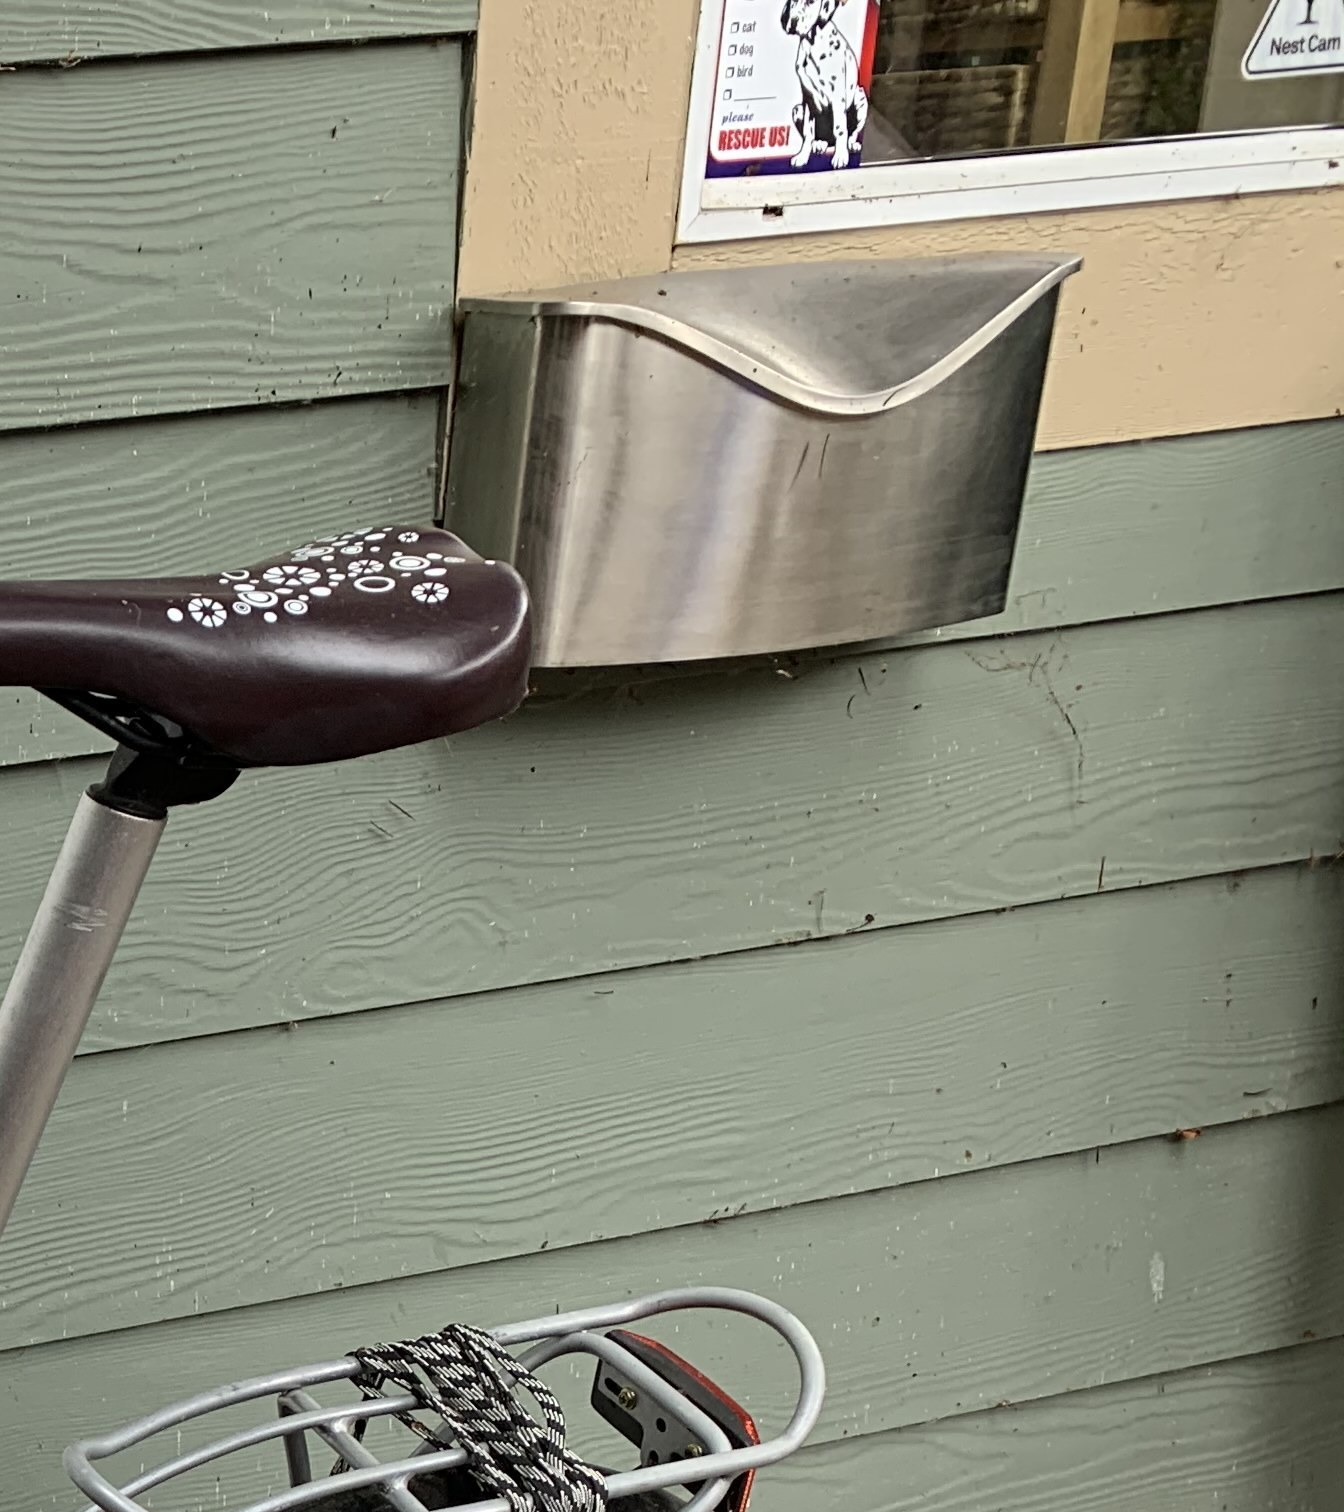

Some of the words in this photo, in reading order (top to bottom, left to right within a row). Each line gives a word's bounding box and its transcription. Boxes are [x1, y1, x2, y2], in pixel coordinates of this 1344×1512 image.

[742, 21, 756, 32] cat
[739, 43, 754, 57] dog
[1270, 37, 1305, 56] Nest
[1308, 34, 1341, 52] Cam
[736, 64, 753, 77] bird
[721, 112, 754, 126] please
[717, 126, 766, 151] RESCUE
[768, 125, 791, 148] US!
